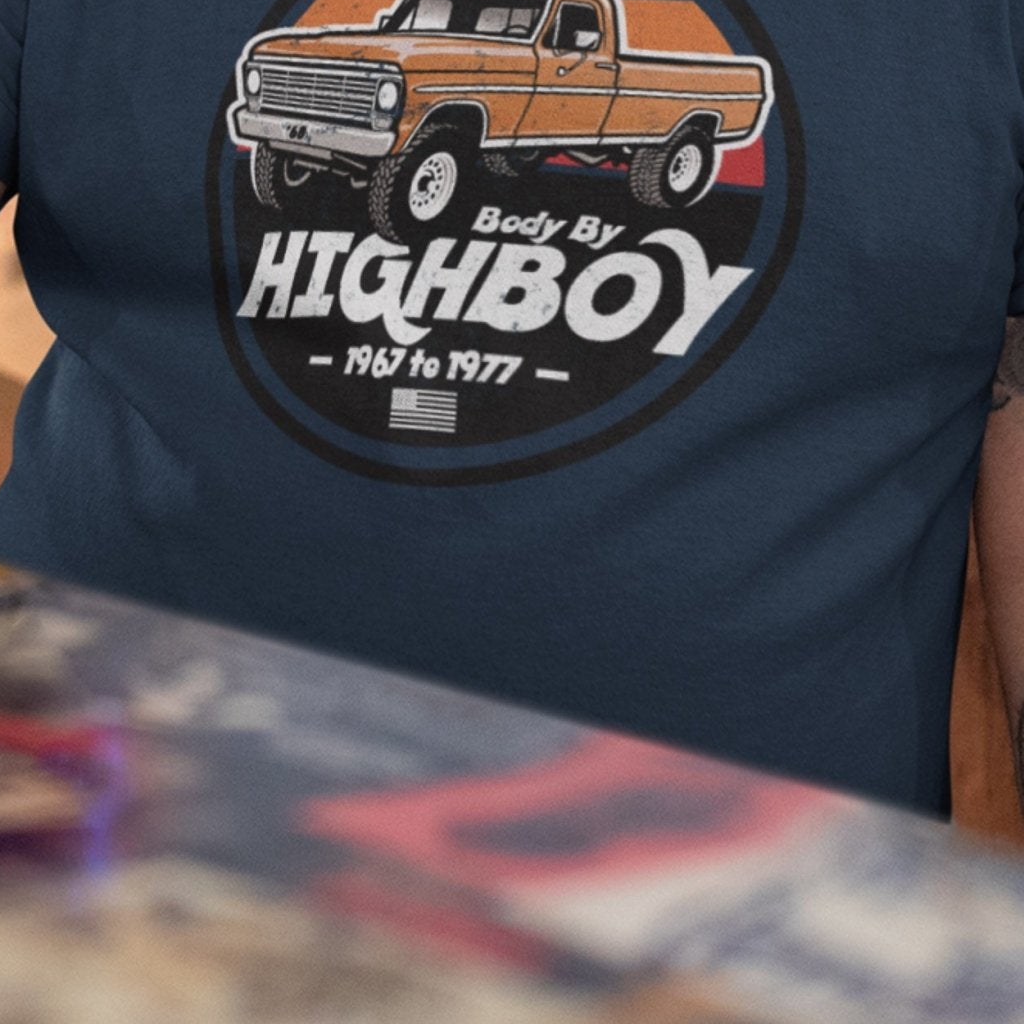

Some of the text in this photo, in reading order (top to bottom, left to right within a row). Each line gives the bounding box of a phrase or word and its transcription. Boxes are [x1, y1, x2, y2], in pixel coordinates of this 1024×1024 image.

[471, 206, 626, 250] Body By
[236, 228, 754, 357] HIGHBOY
[343, 344, 523, 384] 1967 to 1977
